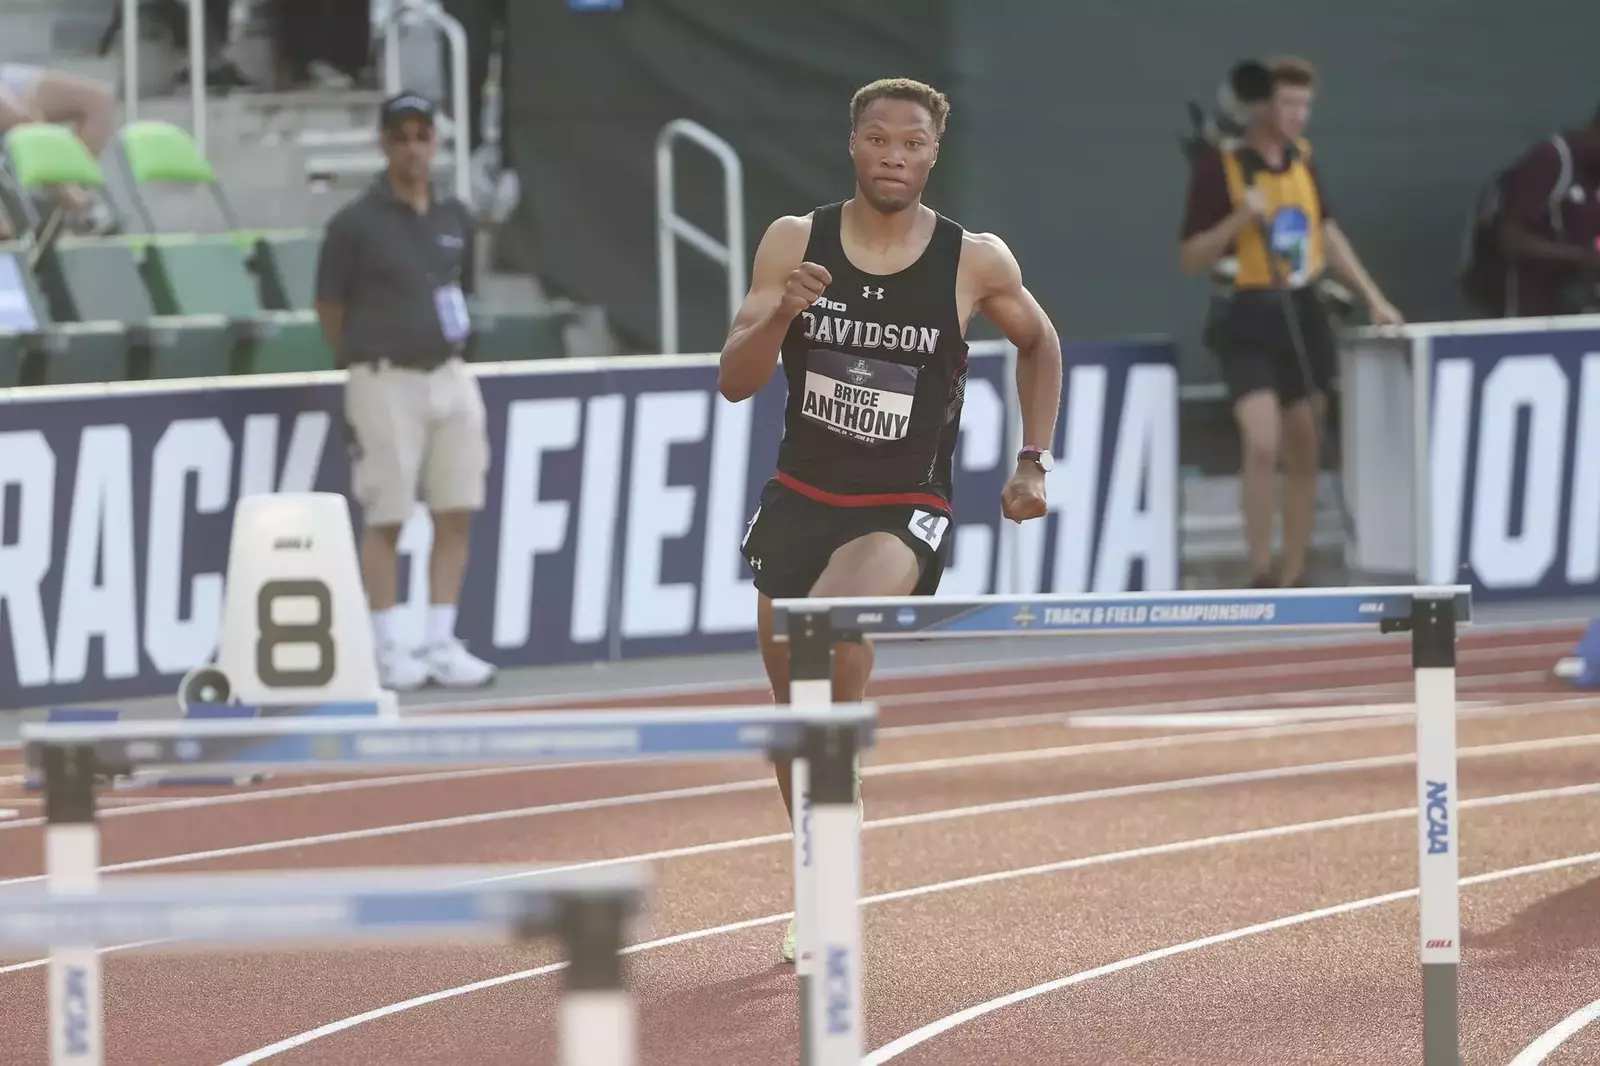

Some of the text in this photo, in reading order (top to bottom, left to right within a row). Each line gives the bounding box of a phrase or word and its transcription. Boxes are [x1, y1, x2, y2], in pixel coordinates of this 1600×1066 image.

[811, 296, 847, 312] A10
[801, 311, 940, 354] DAVIDSON
[833, 382, 880, 407] BRYCE
[804, 391, 908, 439] ANTHONY
[916, 514, 941, 542] 4
[1043, 607, 1092, 625] TRACK
[1105, 605, 1148, 624] FIELD
[1149, 603, 1276, 622] CHAMPIONSHIPS
[256, 578, 336, 689] 8
[1425, 780, 1449, 855] NCAA
[1425, 939, 1453, 949] GILL
